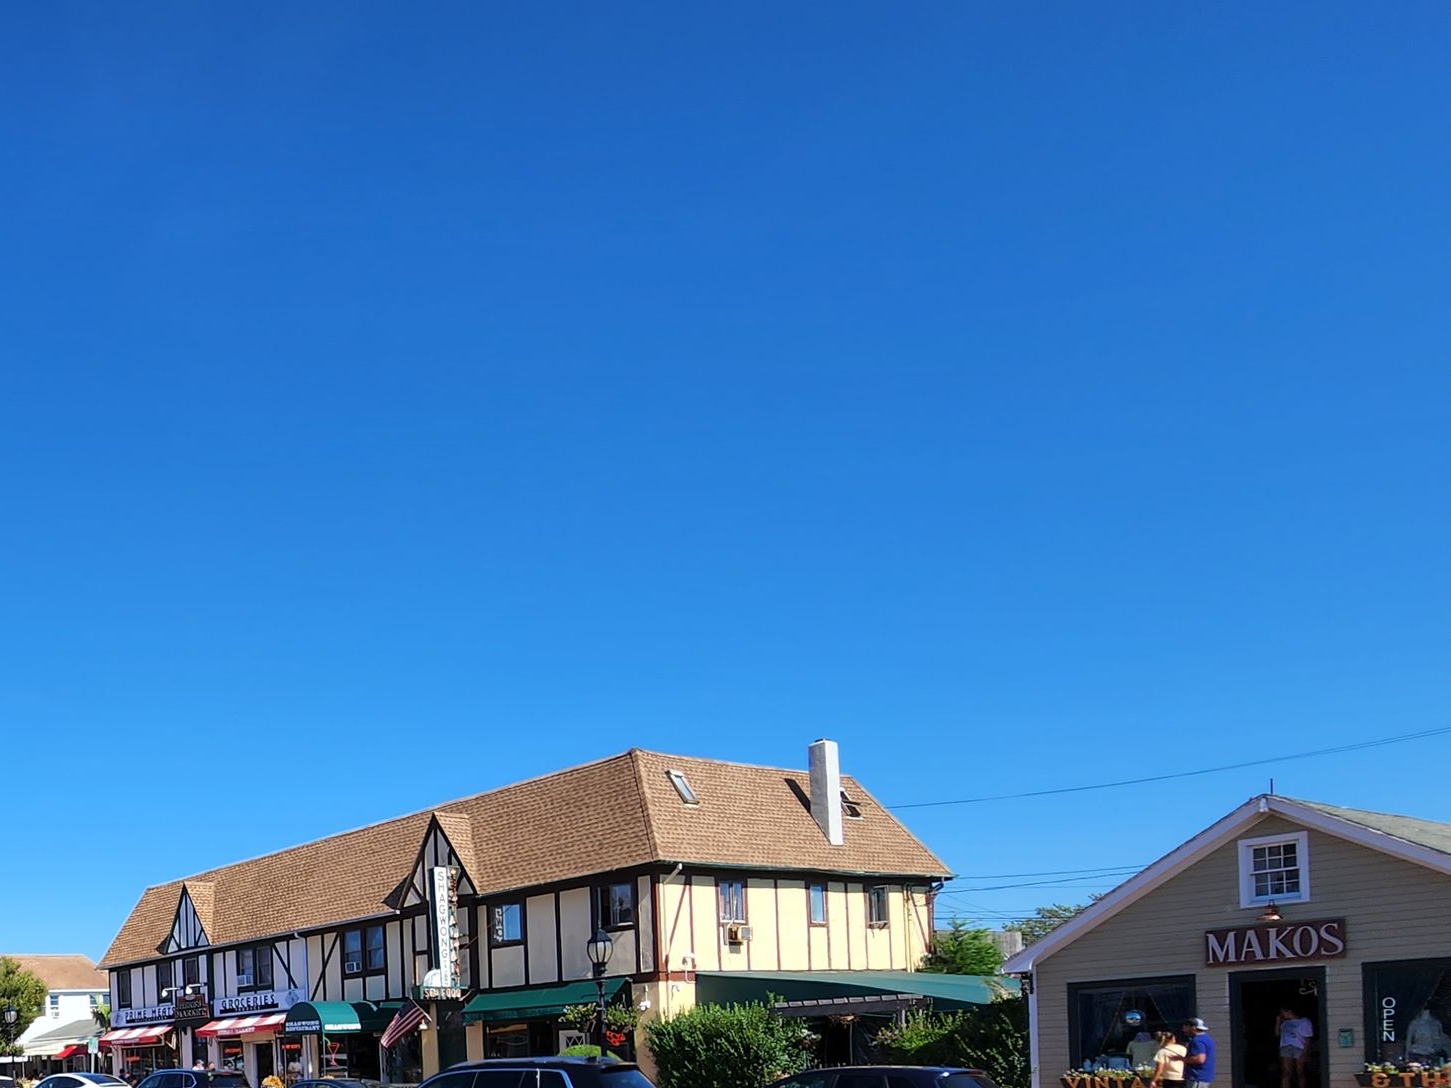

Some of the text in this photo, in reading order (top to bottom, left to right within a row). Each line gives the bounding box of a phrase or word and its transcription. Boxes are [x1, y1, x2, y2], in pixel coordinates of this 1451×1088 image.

[437, 871, 448, 959] SHAGWONG
[1205, 923, 1345, 964] MAKOS
[125, 1009, 147, 1020] PRIME
[151, 1006, 177, 1018] MEATS
[221, 994, 276, 1010] GROCERIES
[1381, 996, 1396, 1042] OPEN
